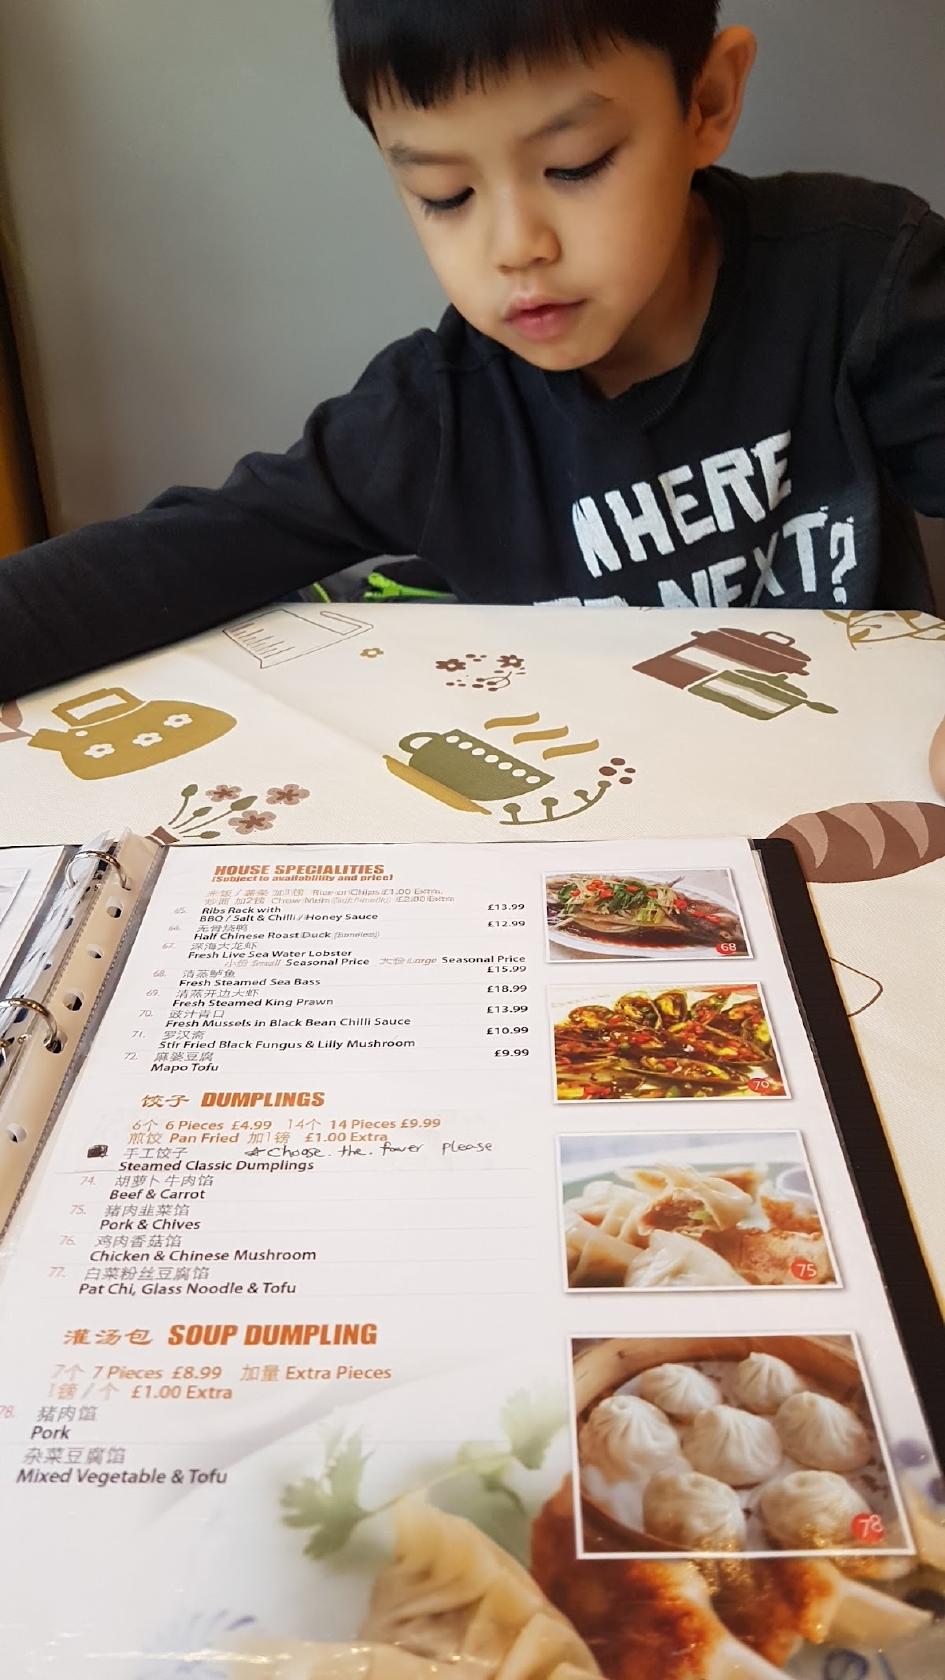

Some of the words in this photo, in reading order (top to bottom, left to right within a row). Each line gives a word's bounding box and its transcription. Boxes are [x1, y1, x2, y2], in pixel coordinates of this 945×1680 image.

[214, 865, 270, 876] HOUSE
[274, 864, 385, 875] SPECIALITIES
[202, 907, 226, 915] Ribs
[256, 906, 281, 914] with
[487, 903, 525, 911] £13.99
[199, 914, 223, 922] BBQ
[233, 914, 254, 922] Salt
[305, 914, 342, 922] Honey
[193, 932, 218, 940] Half
[220, 932, 265, 940] Chinese
[302, 931, 331, 939] Duck
[720, 943, 736, 951] 68
[188, 951, 224, 959] Fresh
[272, 950, 306, 958] Water
[441, 956, 494, 964] Seasonal
[497, 955, 526, 963] Price
[486, 965, 527, 973] £15.99
[179, 979, 211, 987] Fresh
[269, 978, 291, 986] Sea
[293, 978, 321, 986] Bass
[172, 999, 206, 1007] Fresh
[208, 999, 262, 1007] Steamed
[265, 998, 293, 1007] King
[296, 998, 334, 1006] Prawn
[486, 1005, 528, 1013] £13.99
[165, 1020, 199, 1028] Fresh
[202, 1019, 252, 1027] Mussels
[254, 1019, 266, 1027] in
[269, 1019, 302, 1027] Black
[339, 1018, 371, 1026] Chilli
[486, 1026, 529, 1035] £10.99
[158, 1041, 181, 1049] Stir
[183, 1041, 216, 1049] Fried
[219, 1040, 252, 1049] Black
[255, 1040, 302, 1051] Fungus
[305, 1040, 315, 1048] &
[317, 1040, 343, 1050] Lilly
[346, 1039, 415, 1048] Mushroom
[494, 1048, 529, 1057] £9.99
[150, 1063, 189, 1073] Mapo
[191, 1062, 219, 1072] Tofu
[755, 1079, 770, 1090] 70
[140, 1094, 190, 1108] 饺子
[200, 1091, 325, 1108] DUMPLINGS
[165, 1120, 174, 1130] 6
[178, 1120, 224, 1131] Pieces
[231, 1120, 272, 1130] £4.99
[330, 1119, 347, 1129] 14
[351, 1118, 396, 1129] Pieces
[400, 1118, 441, 1129] £9.99
[169, 1133, 198, 1144] Pan
[200, 1133, 240, 1143] Fried
[305, 1132, 346, 1143] £1.00
[350, 1132, 388, 1142] Extra
[123, 1147, 189, 1160] 手工饺子
[442, 1140, 493, 1156] please
[118, 1160, 181, 1171] Steamed
[185, 1160, 232, 1171] Classic
[236, 1159, 314, 1172] Dumplings
[114, 1174, 214, 1187] 胡萝卜牛肉馅
[109, 1189, 142, 1200] Beef
[145, 1189, 157, 1199] &
[160, 1189, 206, 1199] Carrot
[103, 1204, 190, 1217] 猪肉韭菜馅
[99, 1219, 133, 1230] Pork
[137, 1219, 149, 1230] &
[152, 1219, 201, 1230] Chives
[94, 1234, 182, 1248] 鸡肉香菇馅
[89, 1250, 150, 1262] Chicken
[153, 1250, 165, 1261] &
[168, 1250, 230, 1262] Chinese
[233, 1249, 317, 1261] Mushroom
[84, 1266, 210, 1281] 白菜粉丝豆腐馅
[796, 1264, 817, 1278] 75
[79, 1283, 105, 1295] Pat
[108, 1283, 136, 1297] Chi,
[141, 1283, 182, 1295] Glass
[186, 1282, 243, 1295] Noodle
[247, 1283, 259, 1294] &
[263, 1282, 297, 1294] Tofu
[62, 1327, 153, 1346] 灌汤包
[168, 1324, 238, 1346] SOUP
[243, 1323, 378, 1346] DUMPLING
[92, 1365, 103, 1380] 7
[107, 1365, 163, 1380] Pieces
[172, 1365, 222, 1380] £8.99
[285, 1365, 331, 1380] Extra
[336, 1365, 392, 1380] Pieces
[131, 1384, 181, 1399] £1.00
[186, 1384, 232, 1399] Extra
[36, 1406, 98, 1422] 猪肉馅
[30, 1425, 70, 1440] Pork
[24, 1447, 126, 1465] 杂菜豆腐馅
[16, 1468, 72, 1484] Mixed
[76, 1468, 166, 1487] Vegetable
[171, 1469, 185, 1484] &
[189, 1468, 228, 1484] Tofu
[860, 1514, 884, 1537] 78
